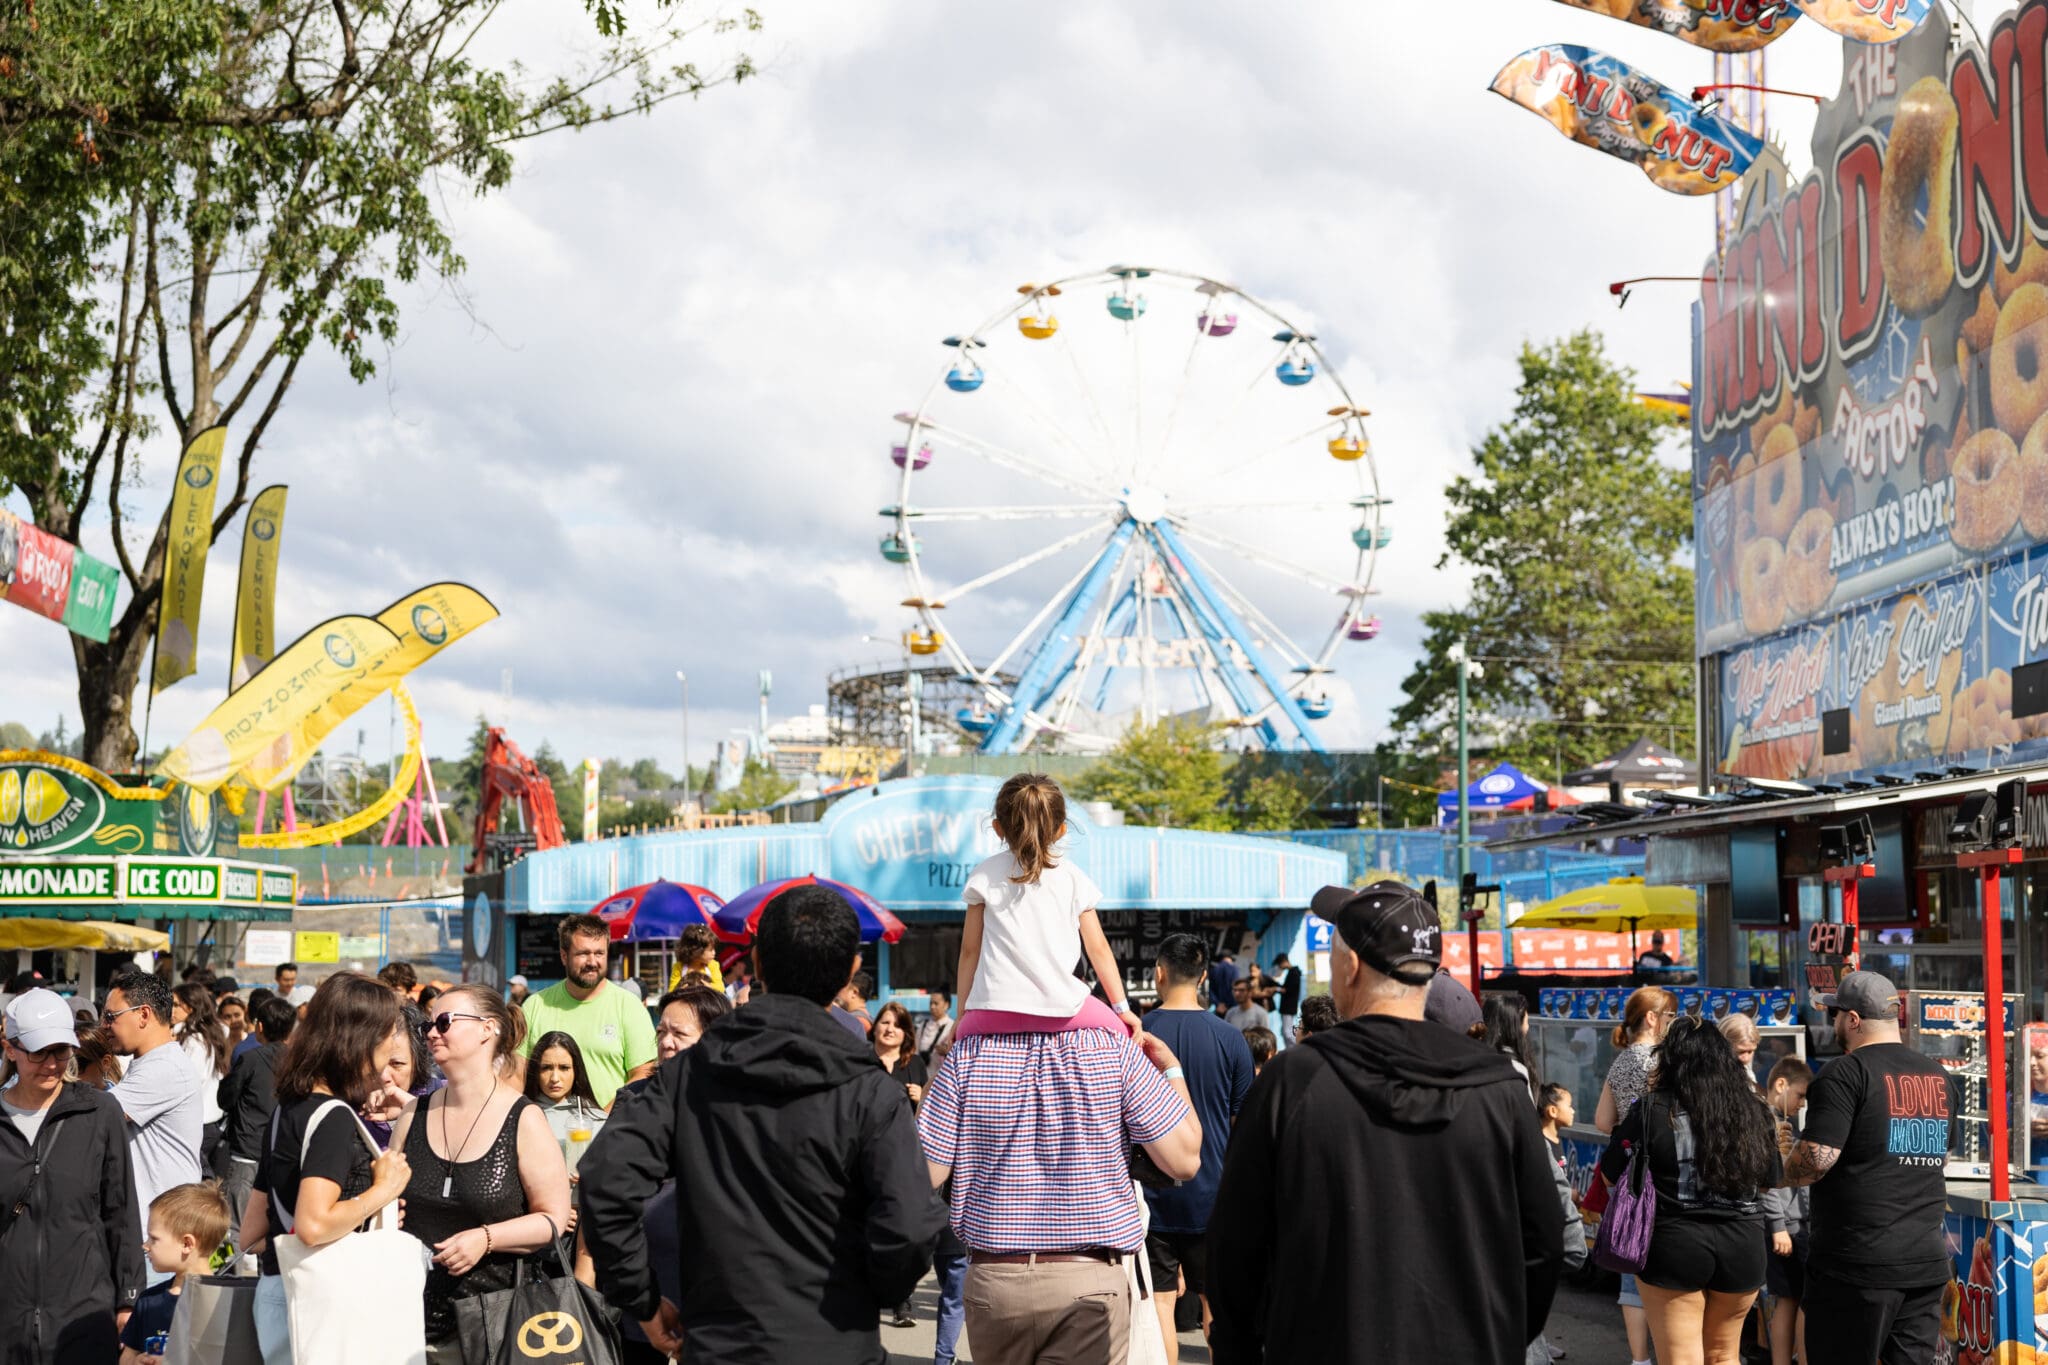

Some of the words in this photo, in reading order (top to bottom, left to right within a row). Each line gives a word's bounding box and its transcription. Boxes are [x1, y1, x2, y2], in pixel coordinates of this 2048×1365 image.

[1628, 78, 1654, 99] THE
[1850, 43, 1897, 122] THE
[1700, 167, 1829, 440] MINI
[1832, 336, 1938, 477] FACTORY
[1903, 476, 1956, 540] HOT!
[35, 551, 61, 591] FOOD
[178, 493, 198, 619] LEMONADE
[77, 575, 99, 608] EXIT
[254, 545, 265, 656] LEMONADE
[433, 590, 465, 633] FRESH
[1898, 576, 1975, 690] Stuffed
[224, 657, 325, 745] LEMONADE
[1874, 700, 1906, 726] Glazed
[1906, 693, 1942, 719] Donuts
[29, 796, 86, 844] HEAVEN
[855, 810, 963, 865] CHEEKY
[130, 868, 161, 895] ICE
[165, 869, 216, 896] COLD
[1314, 925, 1329, 944] 4
[1808, 922, 1846, 954] OPEN
[1925, 1004, 1956, 1021] MINI
[1885, 1075, 1948, 1117] LOVE
[1889, 1117, 1949, 1154] MORE
[1898, 1156, 1942, 1166] TATTOO
